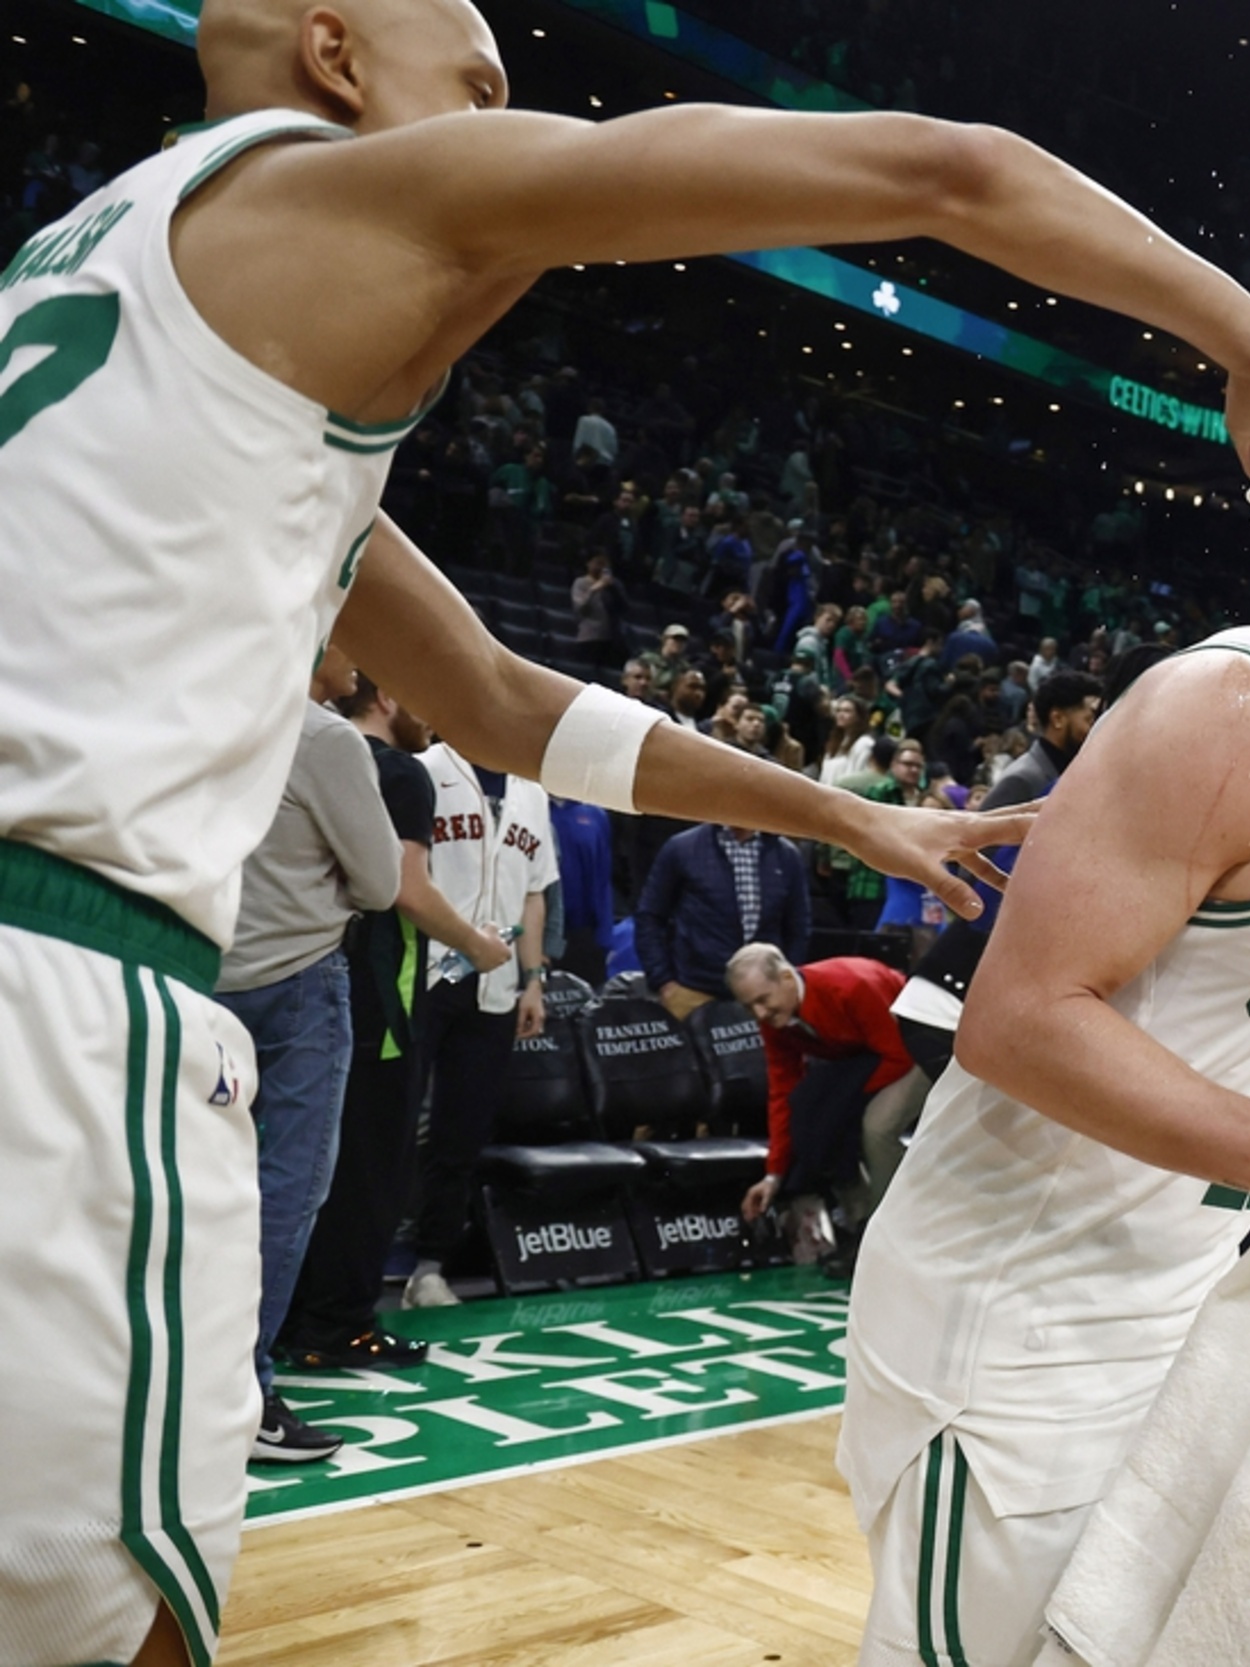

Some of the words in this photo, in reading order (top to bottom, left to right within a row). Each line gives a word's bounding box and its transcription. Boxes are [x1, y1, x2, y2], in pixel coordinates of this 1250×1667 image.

[1109, 375, 1179, 431] CELTICS
[432, 813, 485, 844] RED
[503, 822, 541, 861] SOX
[596, 1020, 669, 1041] FRANKLIN
[515, 1223, 612, 1262] jetBlue
[655, 1214, 739, 1250] jetBlue
